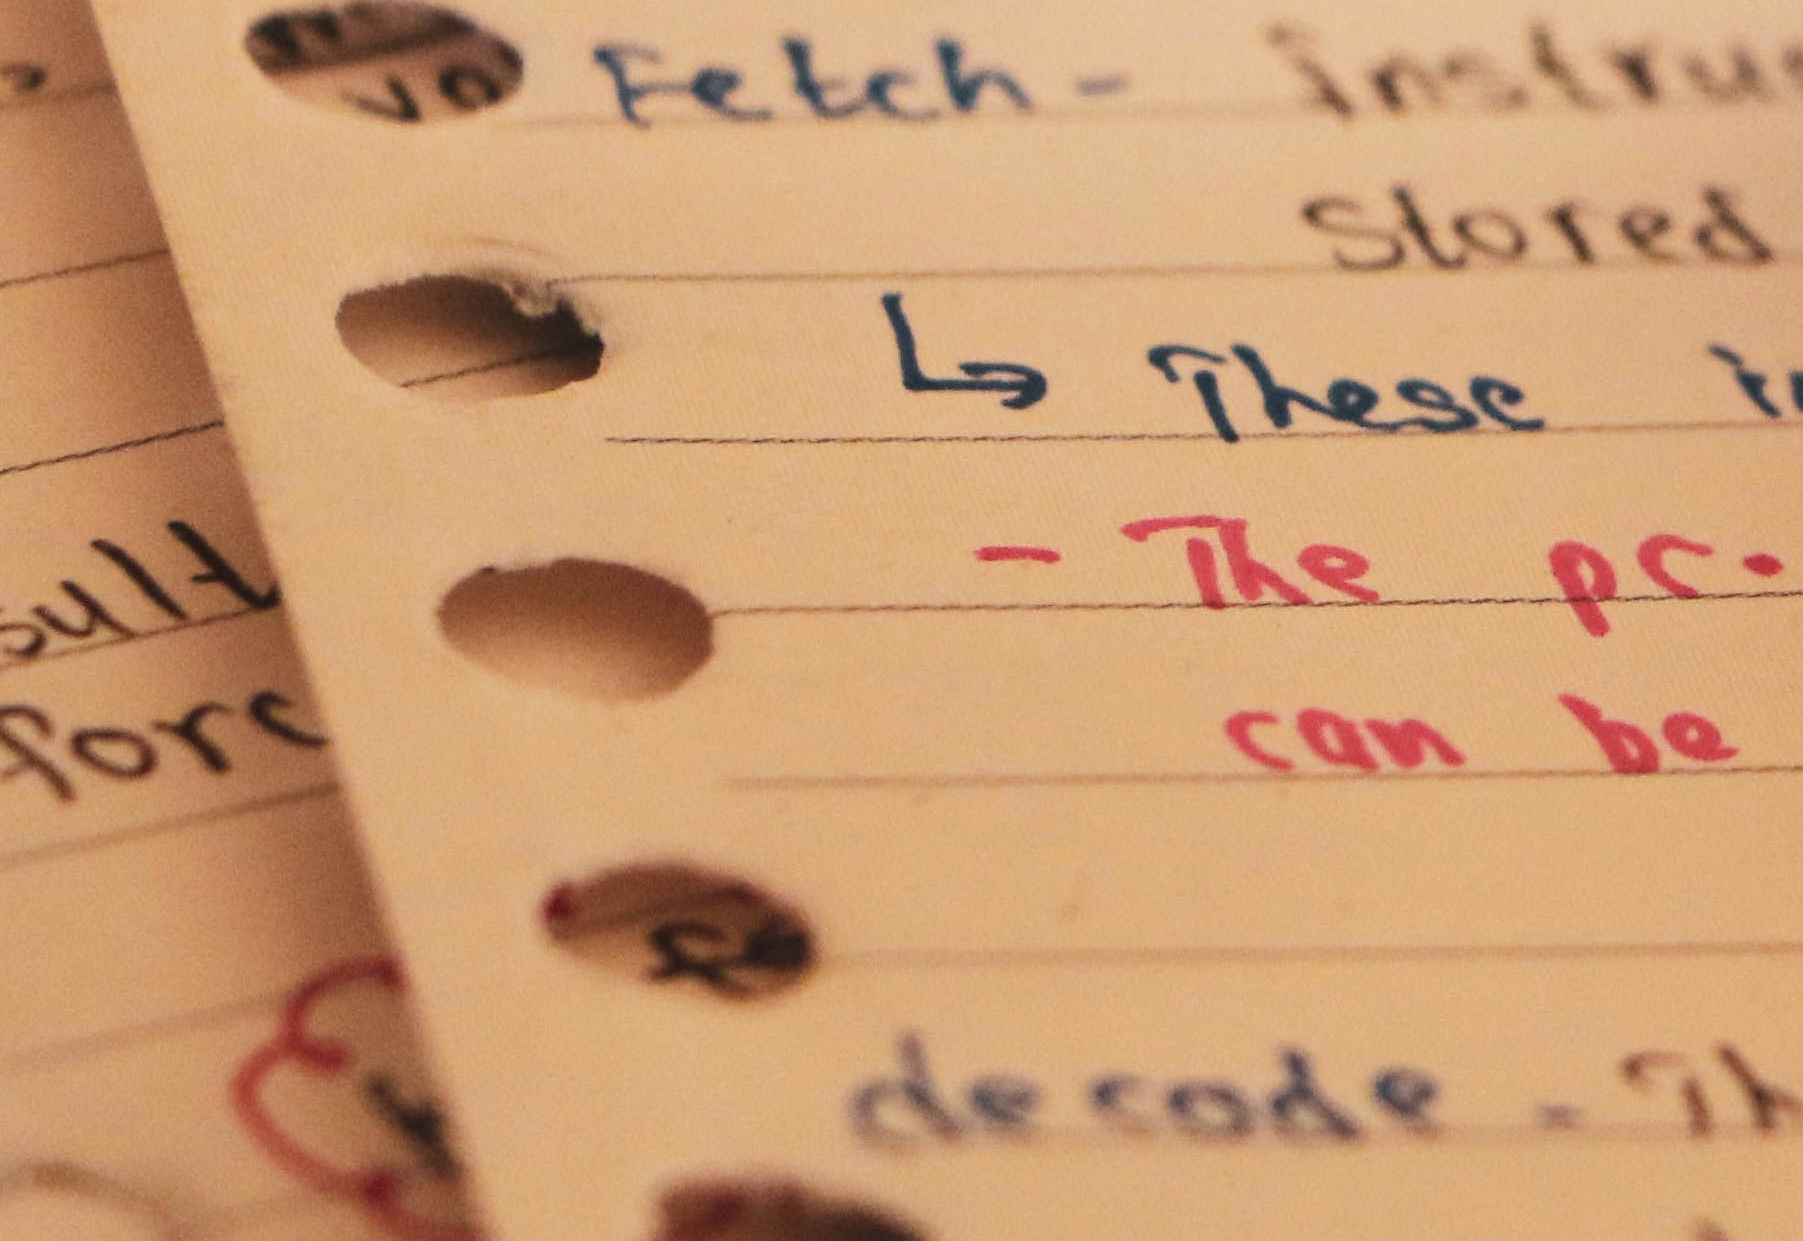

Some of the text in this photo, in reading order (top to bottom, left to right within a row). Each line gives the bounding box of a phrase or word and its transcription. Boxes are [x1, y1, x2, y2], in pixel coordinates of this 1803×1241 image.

[594, 35, 1034, 128] Fetch
[1147, 343, 1544, 443] These
[1122, 516, 1380, 608] The
[1224, 708, 1464, 773] can
[1559, 693, 1738, 775] be
[845, 1031, 1440, 1152] decode
